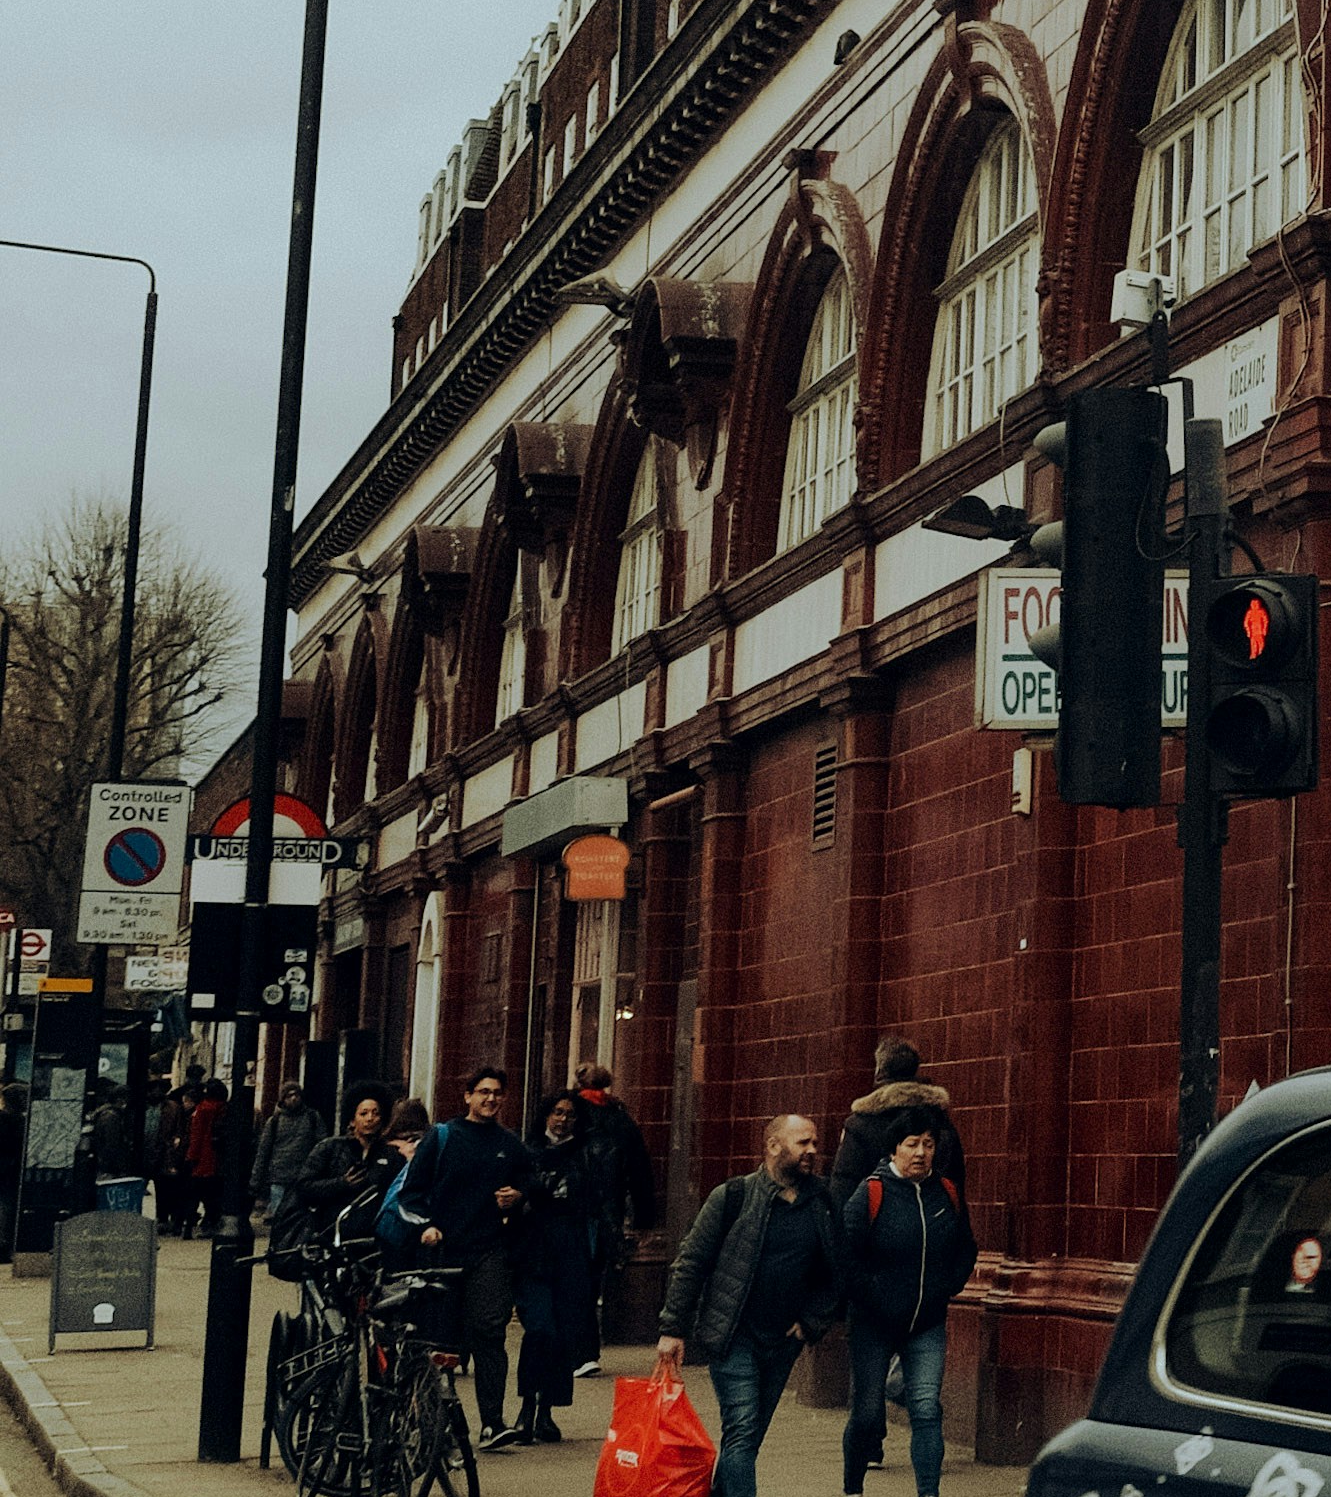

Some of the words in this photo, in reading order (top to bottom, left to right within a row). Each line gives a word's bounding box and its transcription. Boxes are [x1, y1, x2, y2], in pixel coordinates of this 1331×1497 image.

[1228, 355, 1266, 400] ADELAIDE
[1228, 402, 1249, 438] ROAD
[1004, 586, 1061, 644] FO
[100, 789, 182, 803] Controlled
[109, 806, 169, 822] ZONE
[194, 838, 343, 864] UNDEROUND
